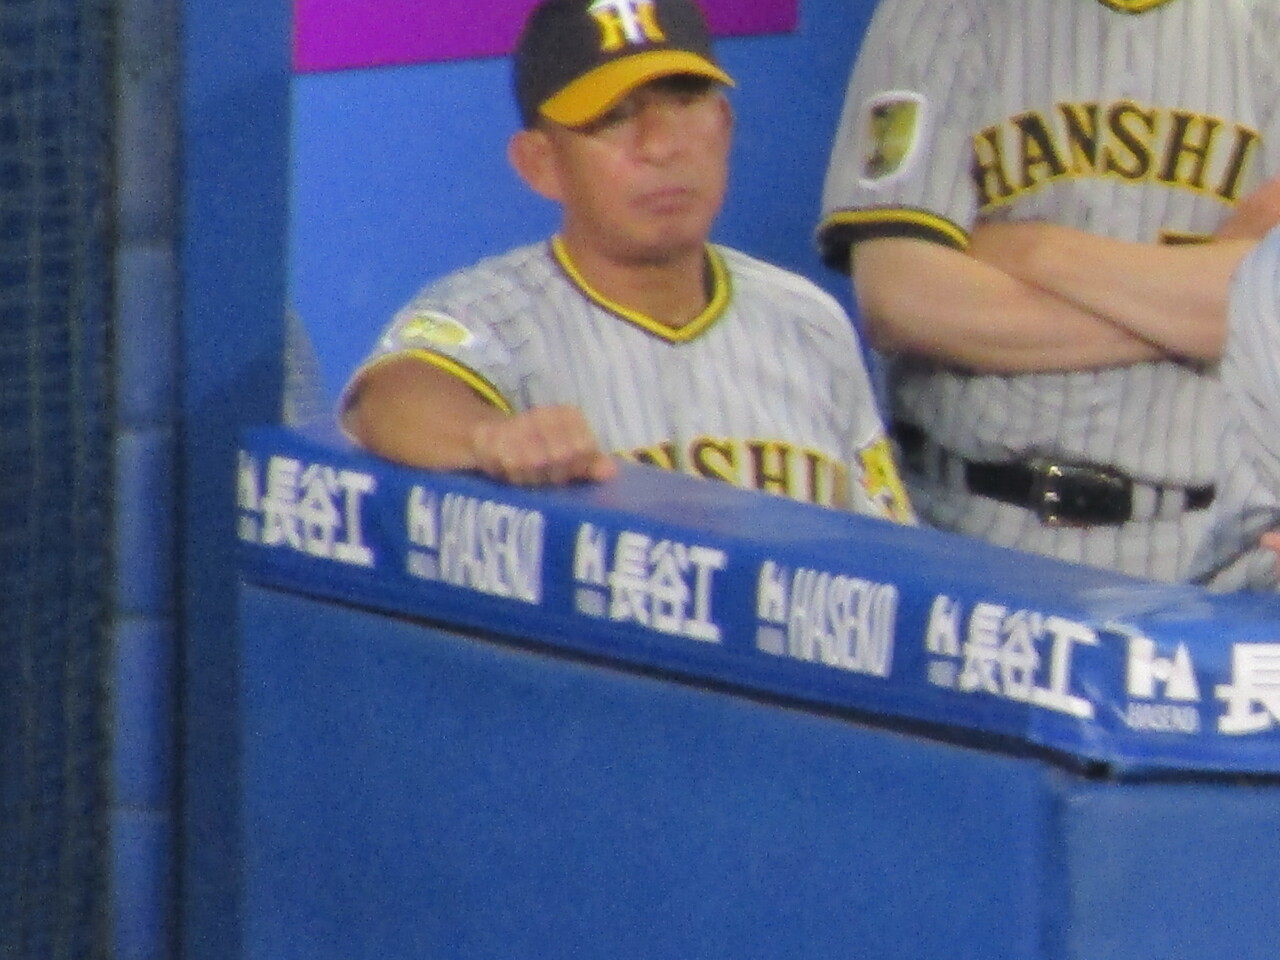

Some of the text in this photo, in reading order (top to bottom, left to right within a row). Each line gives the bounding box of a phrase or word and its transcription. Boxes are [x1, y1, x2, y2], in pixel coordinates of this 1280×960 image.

[261, 453, 377, 569] 長谷工
[608, 529, 728, 644] 長谷工
[958, 600, 1100, 721] 長谷工
